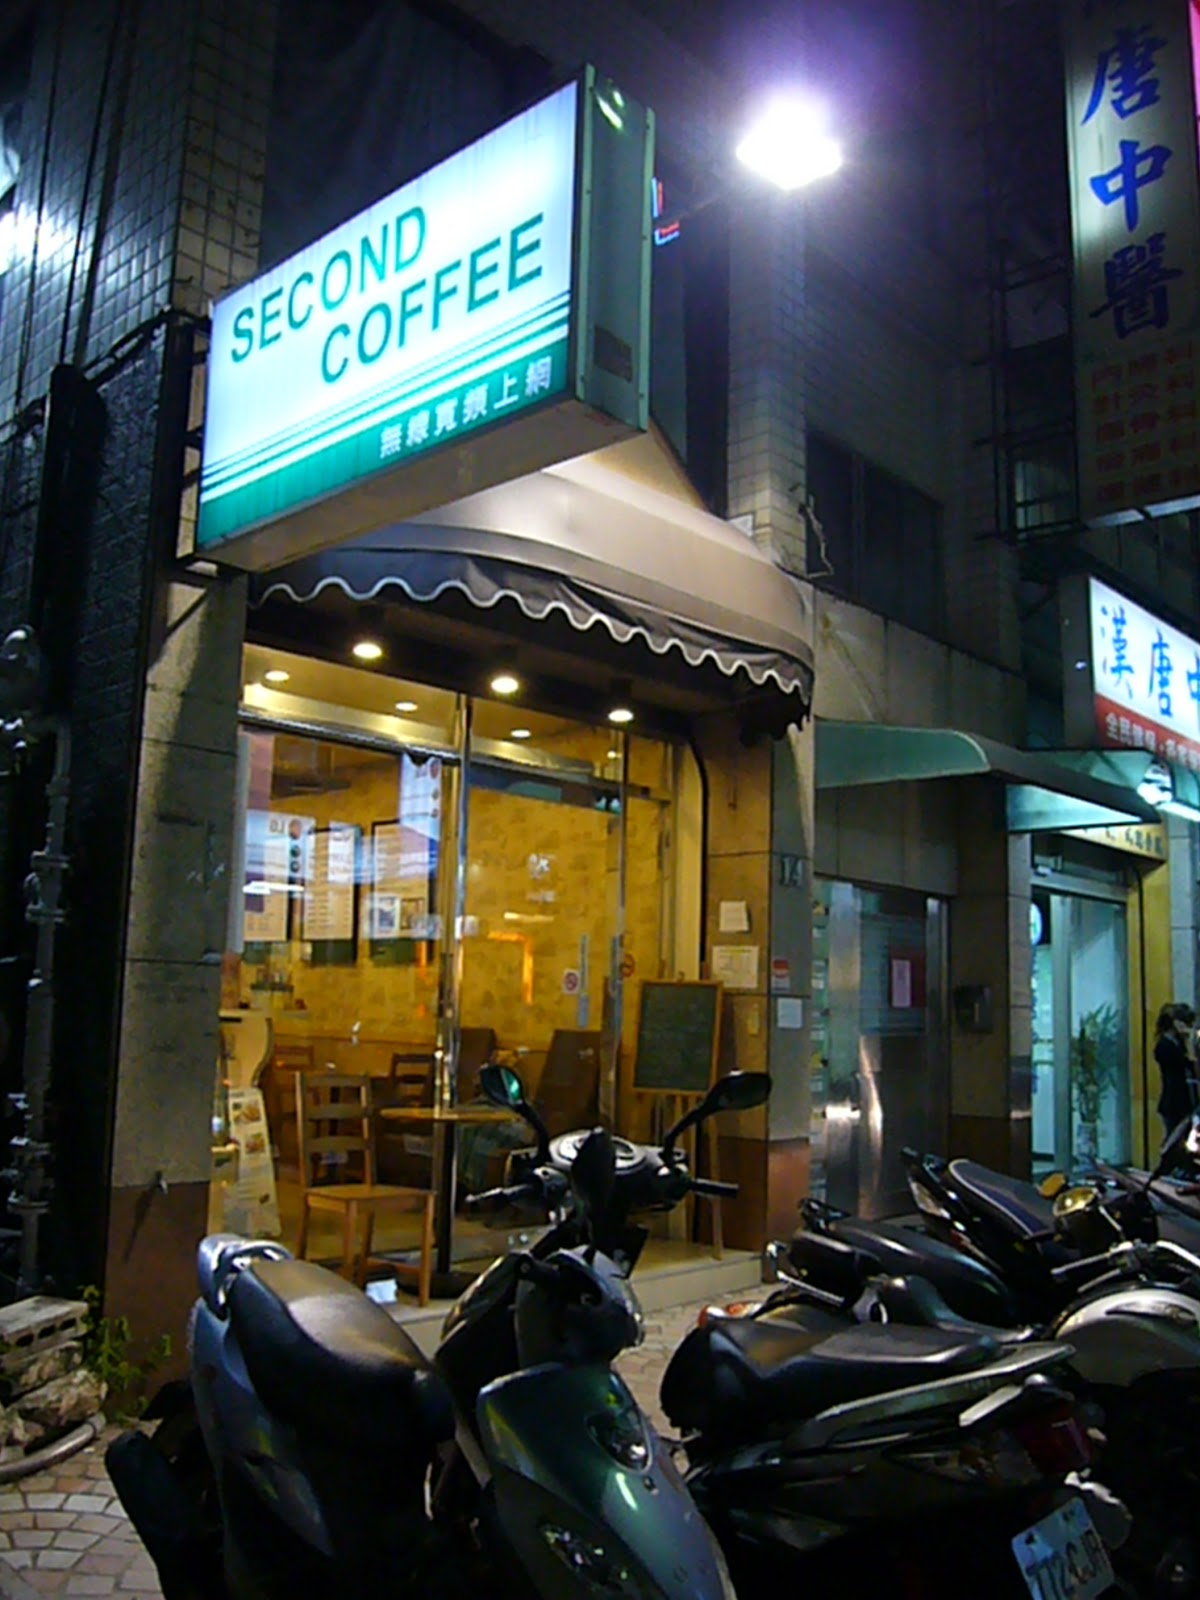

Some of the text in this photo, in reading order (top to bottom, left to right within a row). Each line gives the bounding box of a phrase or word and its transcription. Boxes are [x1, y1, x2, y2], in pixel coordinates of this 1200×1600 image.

[1080, 0, 1185, 340] 唐中醫
[231, 206, 427, 362] SECOND
[321, 212, 544, 383] COFFEE
